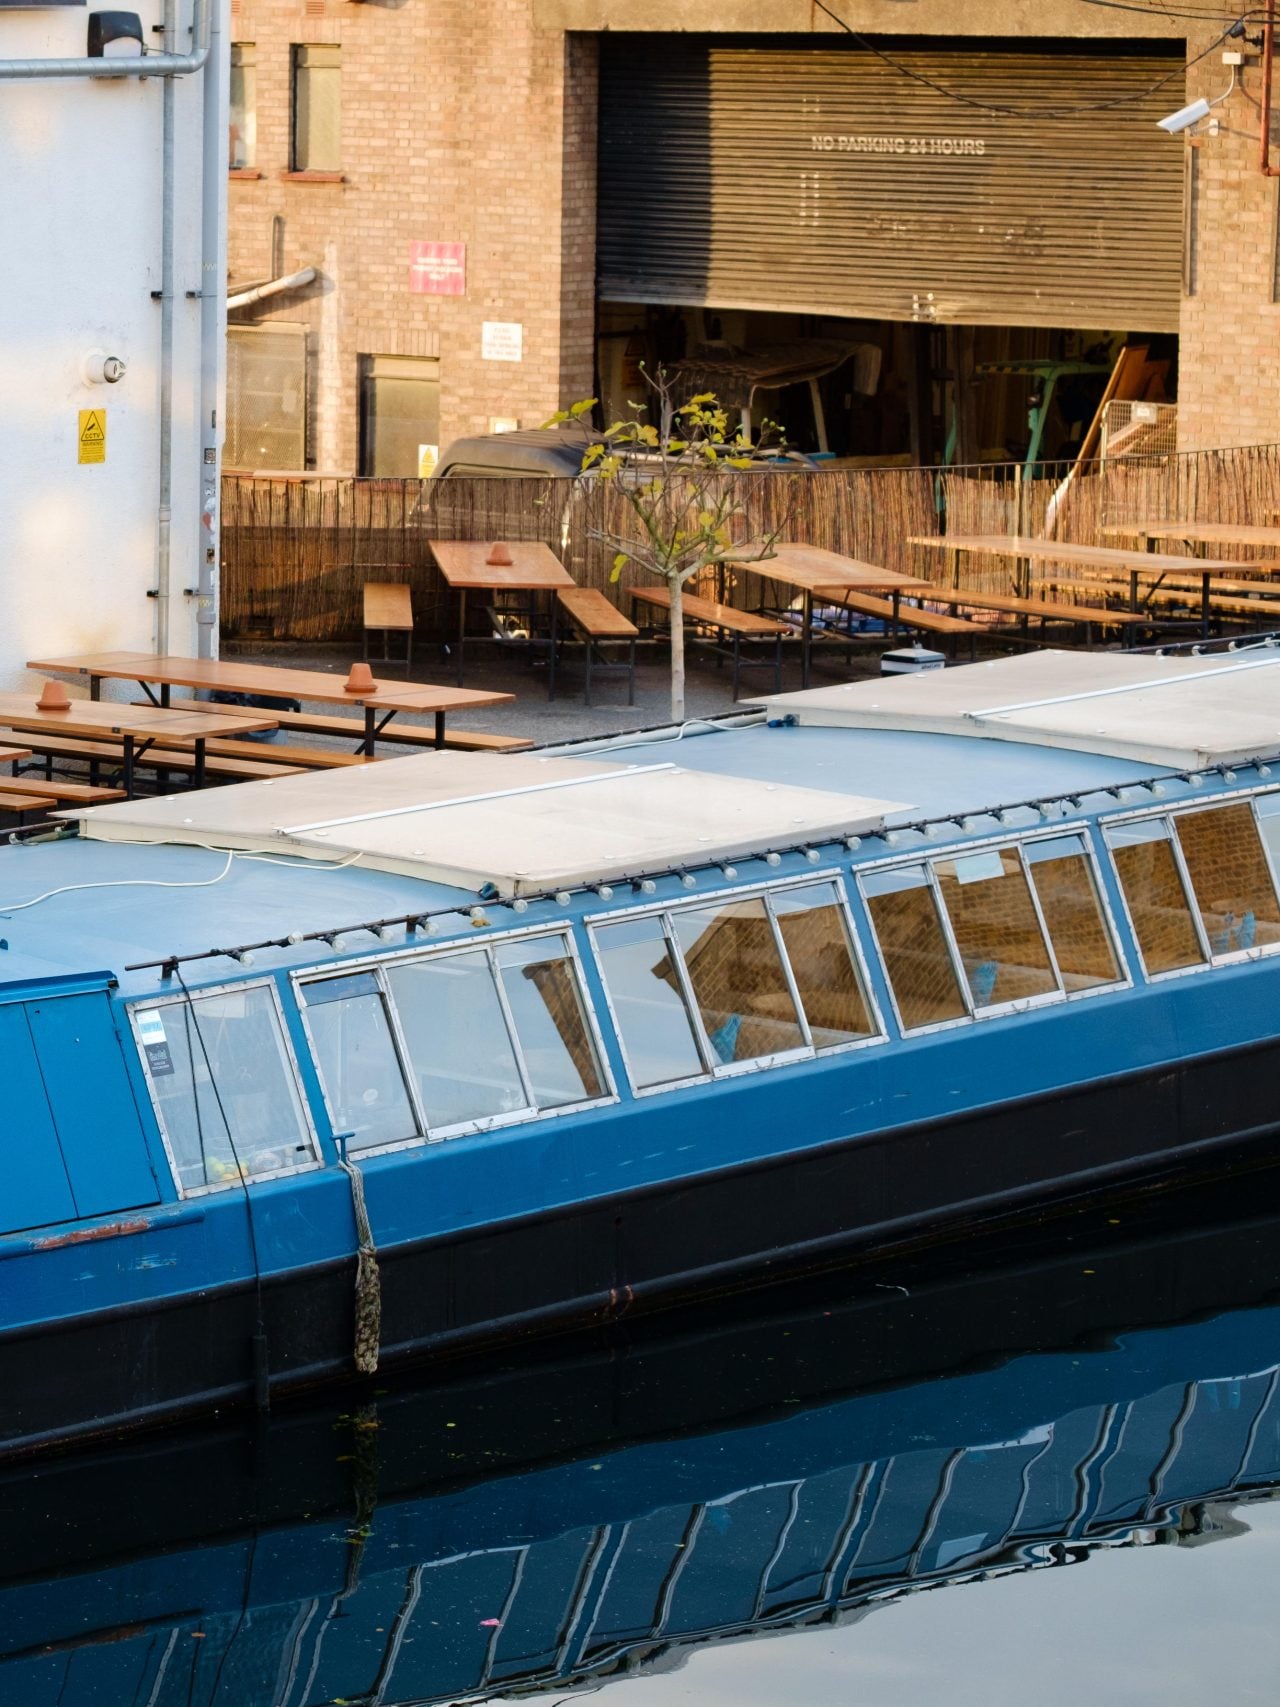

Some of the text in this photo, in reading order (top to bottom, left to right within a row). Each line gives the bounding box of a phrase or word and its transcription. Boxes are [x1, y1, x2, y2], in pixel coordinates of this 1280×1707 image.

[812, 135, 985, 155] NO PARKING 24 HOURS
